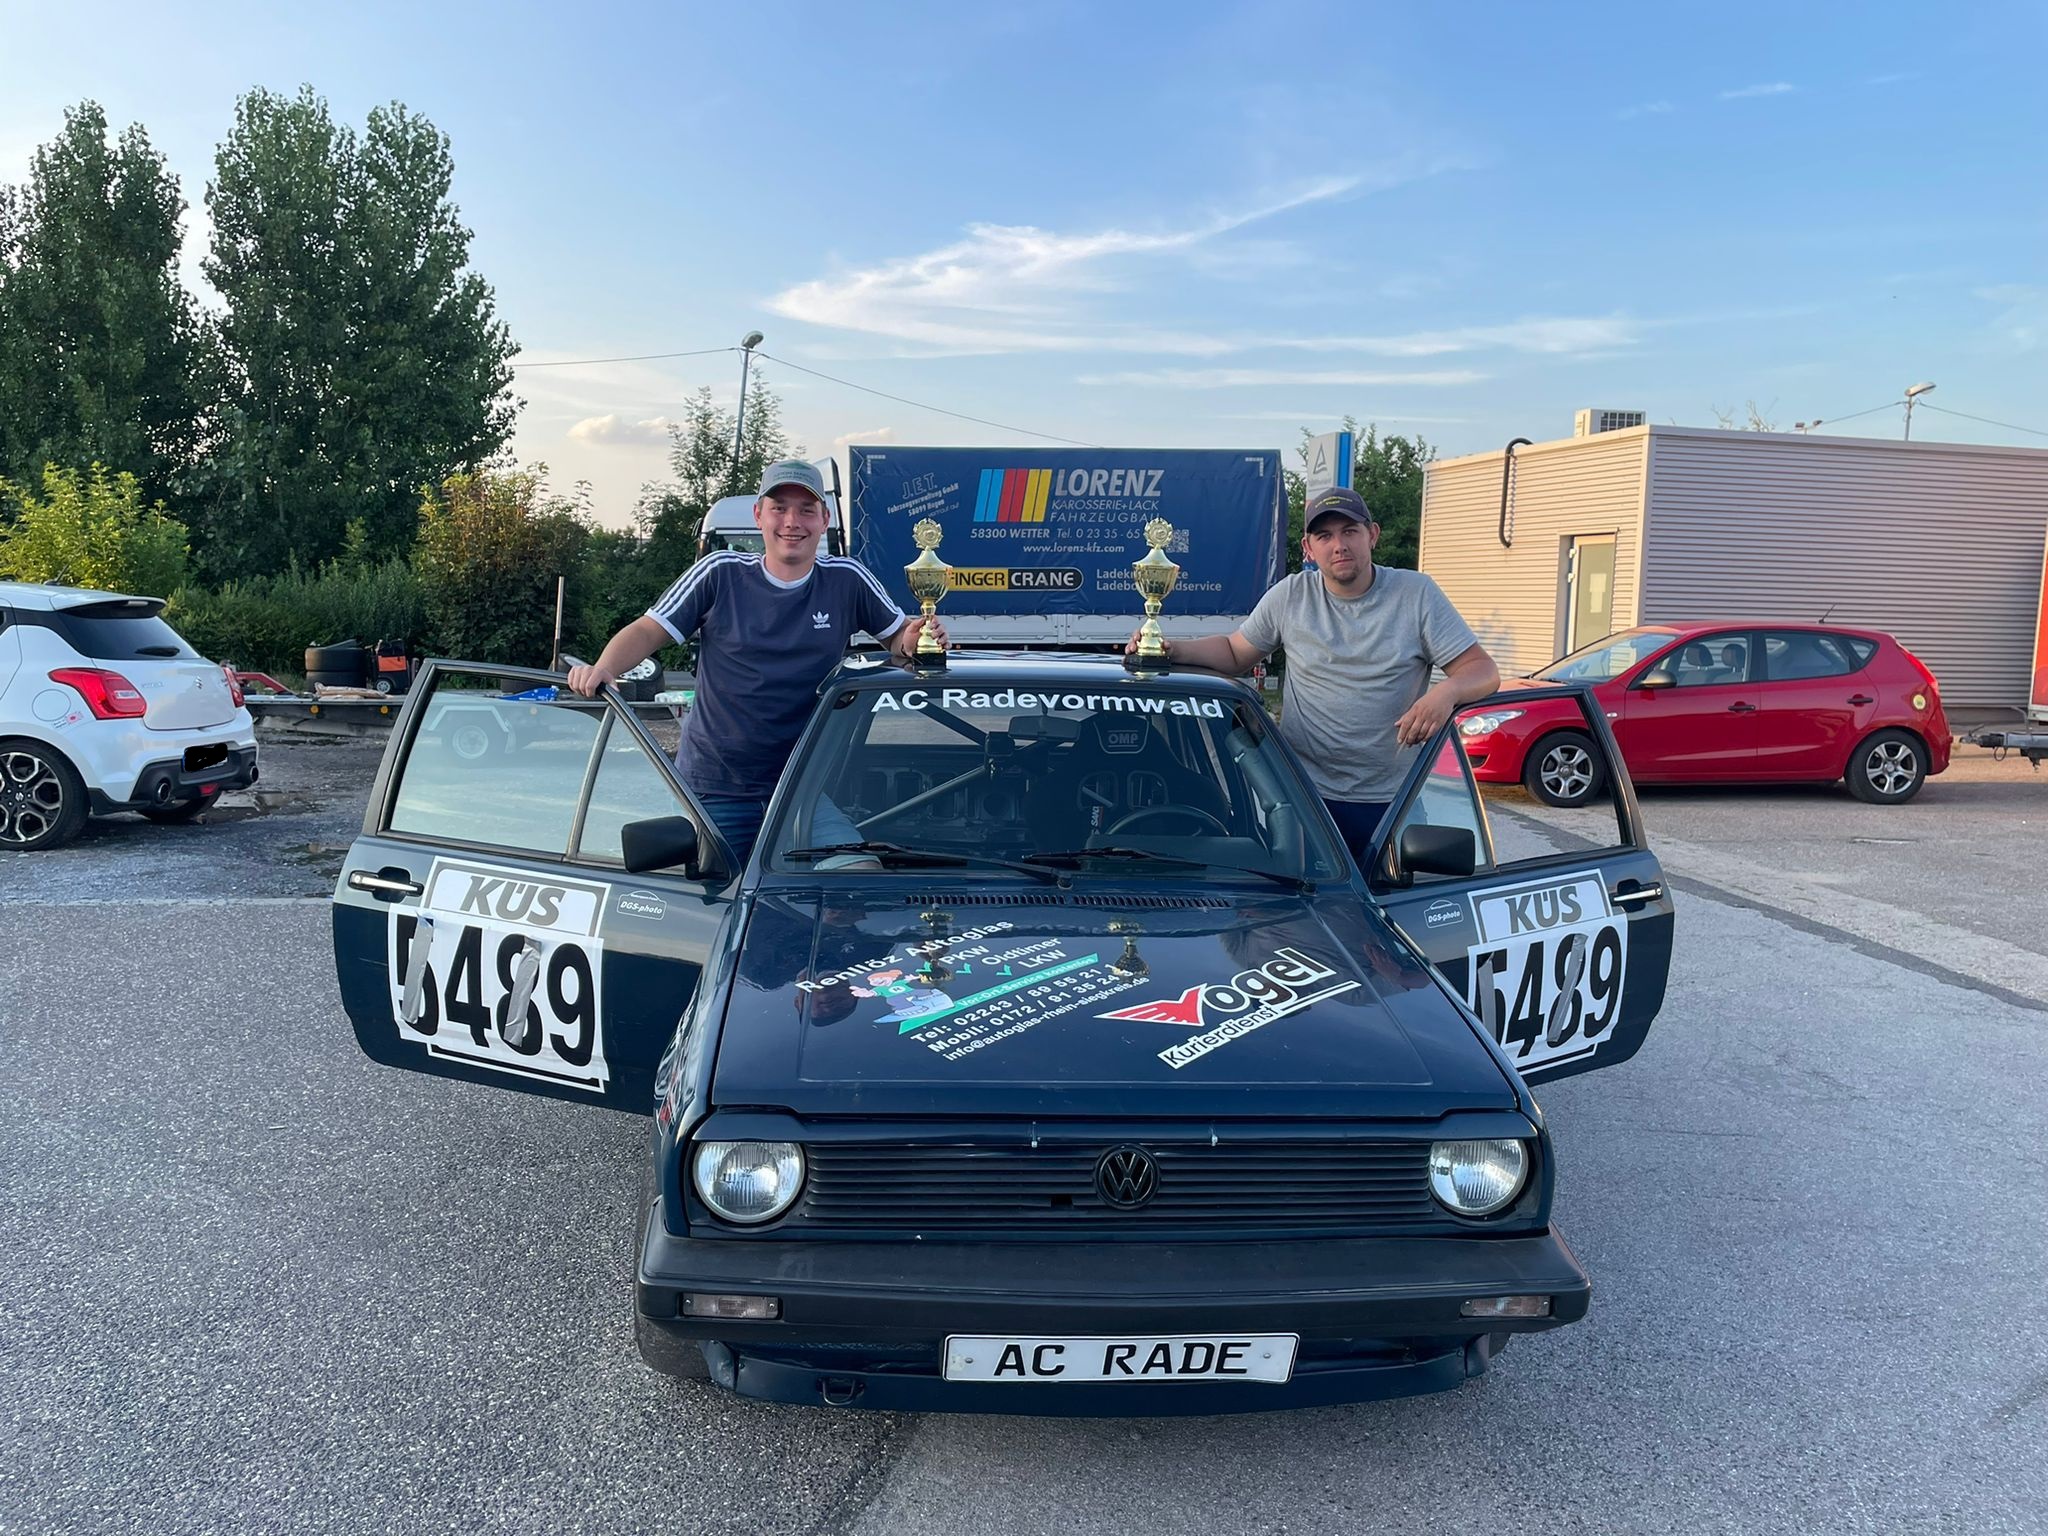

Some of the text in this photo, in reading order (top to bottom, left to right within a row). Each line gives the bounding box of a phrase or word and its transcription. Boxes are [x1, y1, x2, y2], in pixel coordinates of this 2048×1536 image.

[1055, 470, 1164, 497] LORENZ
[1051, 499, 1159, 511] KAROSSERIE+LACK
[970, 528, 1007, 539] 58300
[1010, 528, 1051, 539] WETTER
[1057, 528, 1072, 539] Tel.
[1076, 528, 1083, 539] 0
[1086, 528, 1099, 539] 23
[1104, 528, 1118, 539] 35
[1126, 528, 1140, 539] 65
[1023, 541, 1125, 553] www.lorenz-kfz.com
[1011, 572, 1074, 586] CRANE
[871, 689, 1224, 718] AC Radevormwald
[1108, 733, 1138, 744] OMP
[460, 875, 567, 927] KÜS
[620, 901, 664, 914] DGS-photo
[1505, 886, 1583, 934] KÜS
[904, 921, 1014, 958] Autoglas
[982, 938, 1062, 966] Oldtimer
[939, 945, 990, 965] PKW
[1018, 949, 1067, 968] LKW
[1093, 947, 1337, 1027] Vogel
[911, 1024, 952, 1043] Tel:
[954, 1000, 1012, 1026] 02243
[1027, 985, 1051, 997] 89
[1053, 976, 1078, 988] 55
[1079, 968, 1102, 979] 21
[927, 1023, 989, 1052] Mobil:
[989, 1006, 1037, 1026] 0172
[1047, 991, 1072, 1003] 91
[1073, 981, 1096, 993] 35
[1097, 974, 1120, 985] 24
[1163, 1006, 1279, 1065] Kurierdienst
[993, 1342, 1253, 1376] AC RADE
